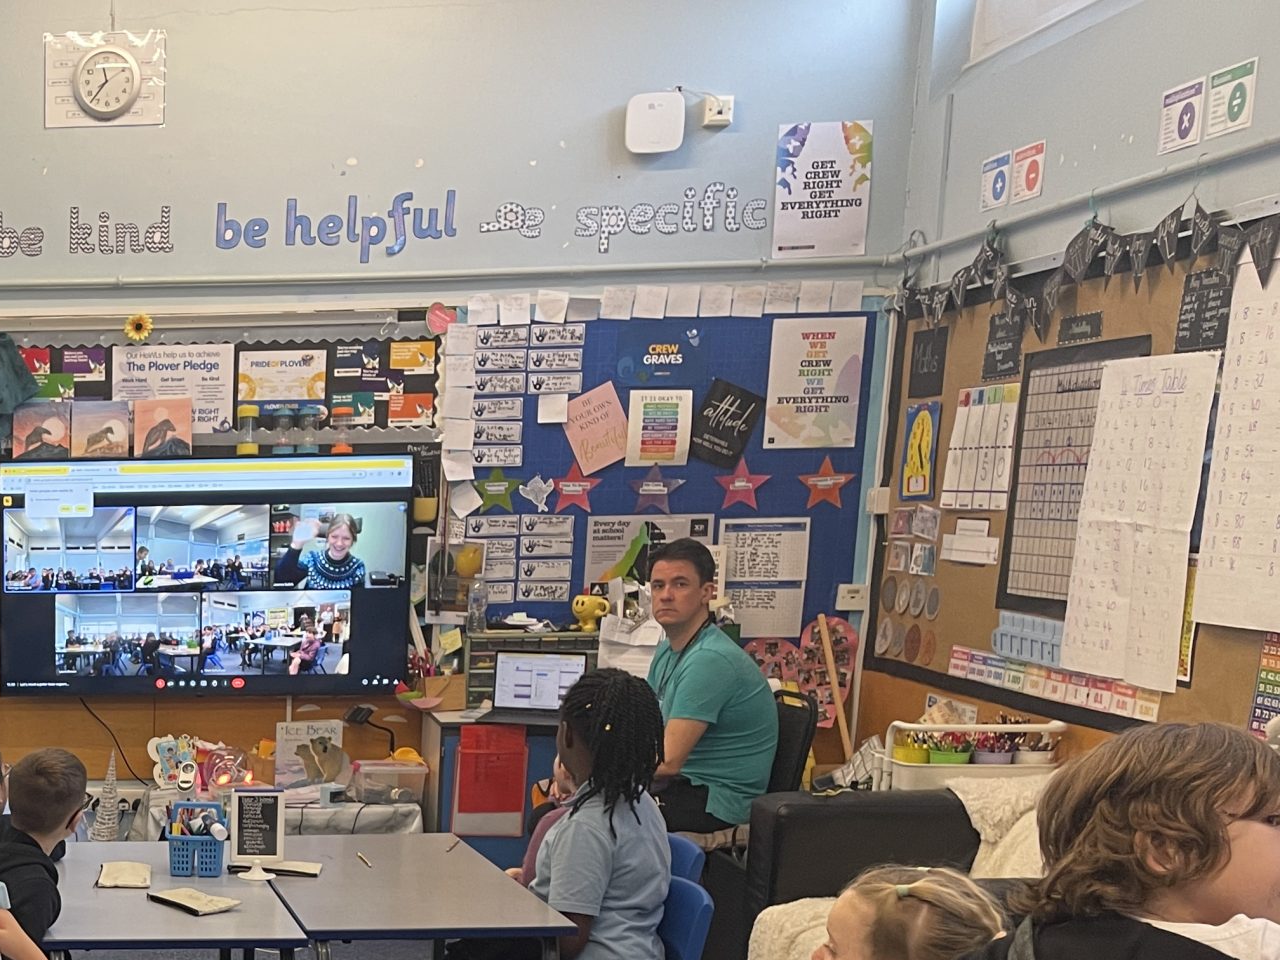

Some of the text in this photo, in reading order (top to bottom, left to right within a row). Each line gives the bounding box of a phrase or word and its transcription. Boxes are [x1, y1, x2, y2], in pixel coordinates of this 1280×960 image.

[812, 160, 836, 170] GET
[805, 170, 841, 180] CREW
[803, 180, 842, 190] RIGHT
[810, 190, 834, 200] GET
[781, 198, 862, 211] EVERYTHING
[575, 182, 767, 254] specific
[801, 209, 840, 219] RIGHT
[70, 206, 173, 255] kind
[216, 190, 456, 263] be helpful
[801, 332, 836, 341] WHEN
[649, 344, 679, 354] CREW
[809, 341, 826, 350] WE
[163, 351, 177, 359] help
[643, 354, 683, 365] GRAVES
[806, 351, 828, 359] GET
[127, 360, 219, 372] The Plover Pledge
[800, 360, 832, 368] CREW
[798, 368, 833, 377] RIGHT
[806, 378, 824, 386] WE
[1161, 367, 1187, 391] Table
[803, 387, 824, 395] GET
[582, 398, 592, 407] BE
[777, 396, 849, 404] EVERYTHING
[569, 399, 612, 425] YOUR OWN
[795, 405, 830, 413] RIGHT
[579, 412, 610, 431] KIND OF
[594, 520, 631, 529] Every day
[285, 724, 337, 735] ICE BEAR
